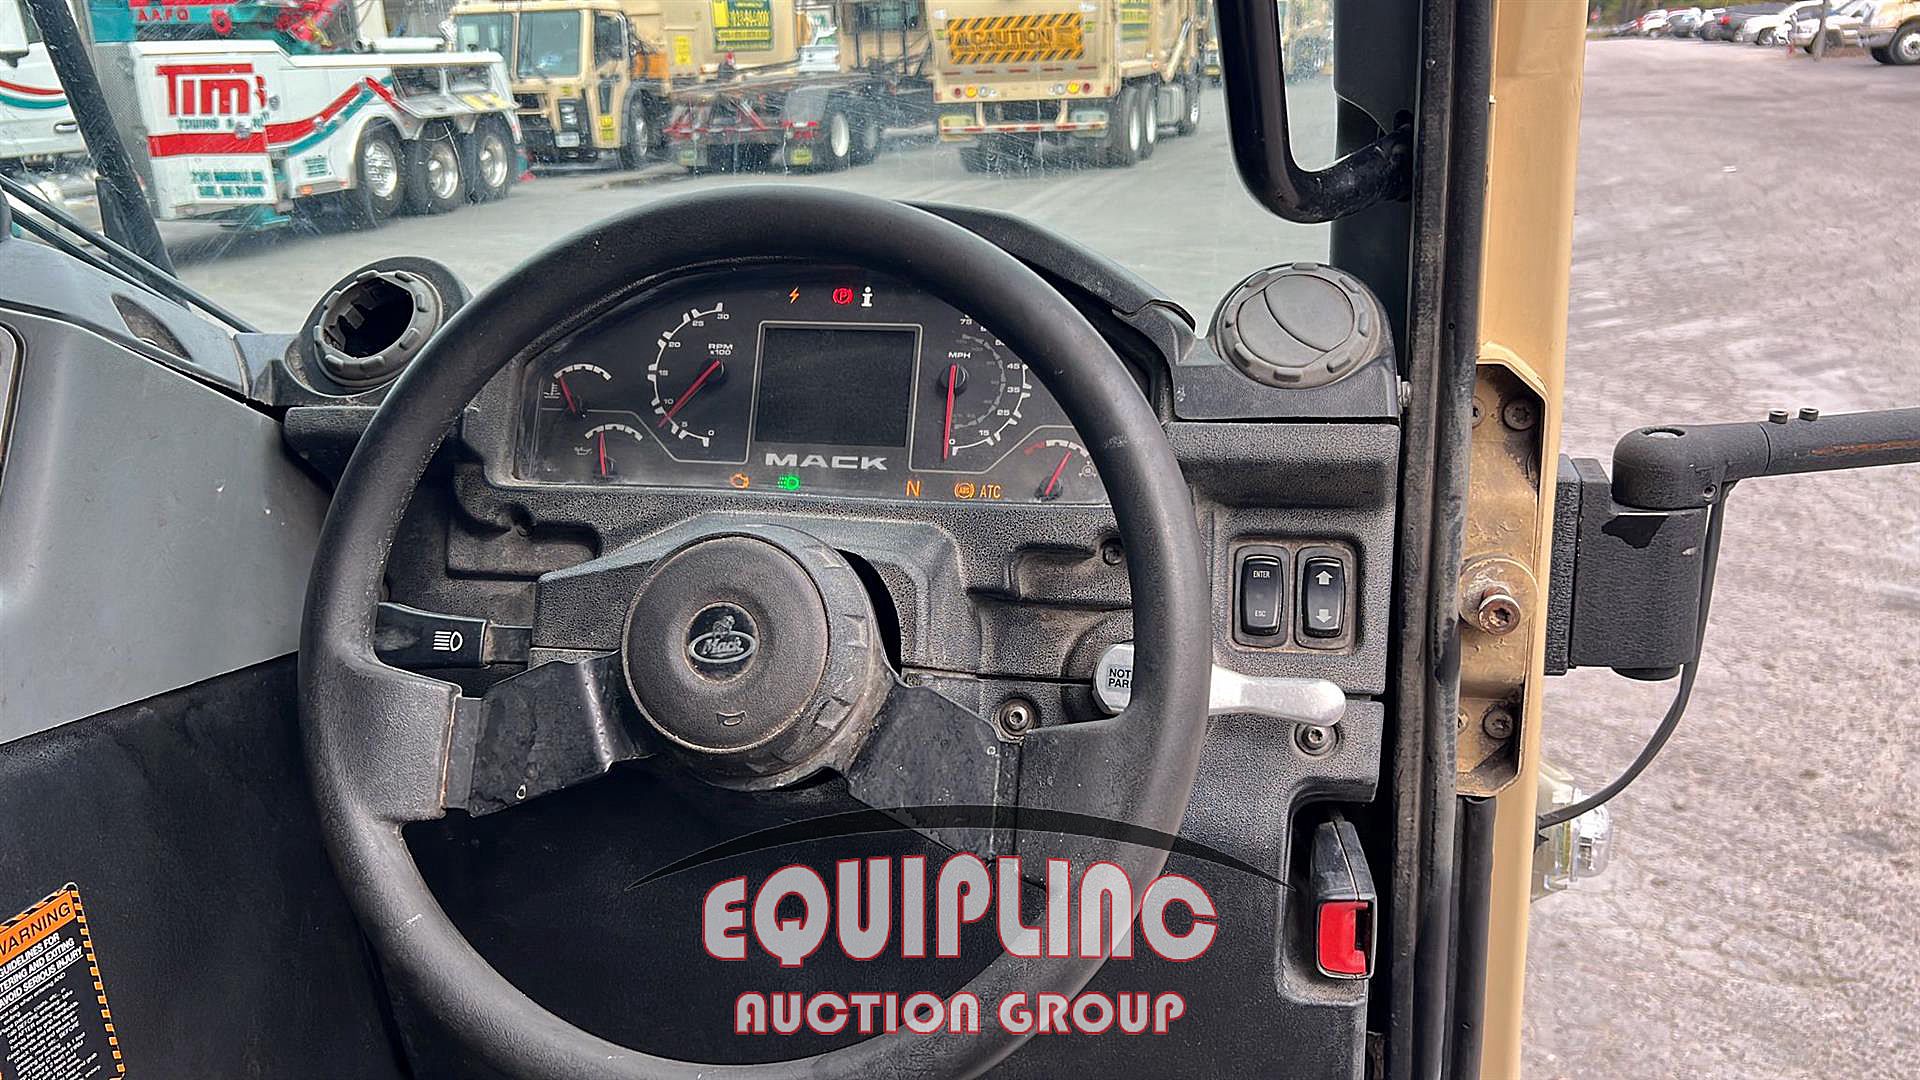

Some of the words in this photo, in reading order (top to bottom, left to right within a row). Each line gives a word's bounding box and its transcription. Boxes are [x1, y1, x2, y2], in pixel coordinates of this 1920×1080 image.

[969, 28, 1053, 46] CAUTION
[765, 452, 887, 470] MACK
[906, 480, 921, 497] N
[980, 484, 1001, 498] ATC
[1253, 570, 1270, 579] ENTER
[1255, 610, 1266, 618] ESC
[700, 636, 744, 658] Mack
[1109, 668, 1131, 679] NOT
[43, 932, 60, 947] FOR
[0, 968, 28, 992] TERING
[28, 957, 44, 973] AND
[46, 937, 75, 962] EXITING
[0, 986, 22, 1007] AVOID
[23, 964, 57, 991] SERIOUS
[56, 945, 82, 969] INJURY
